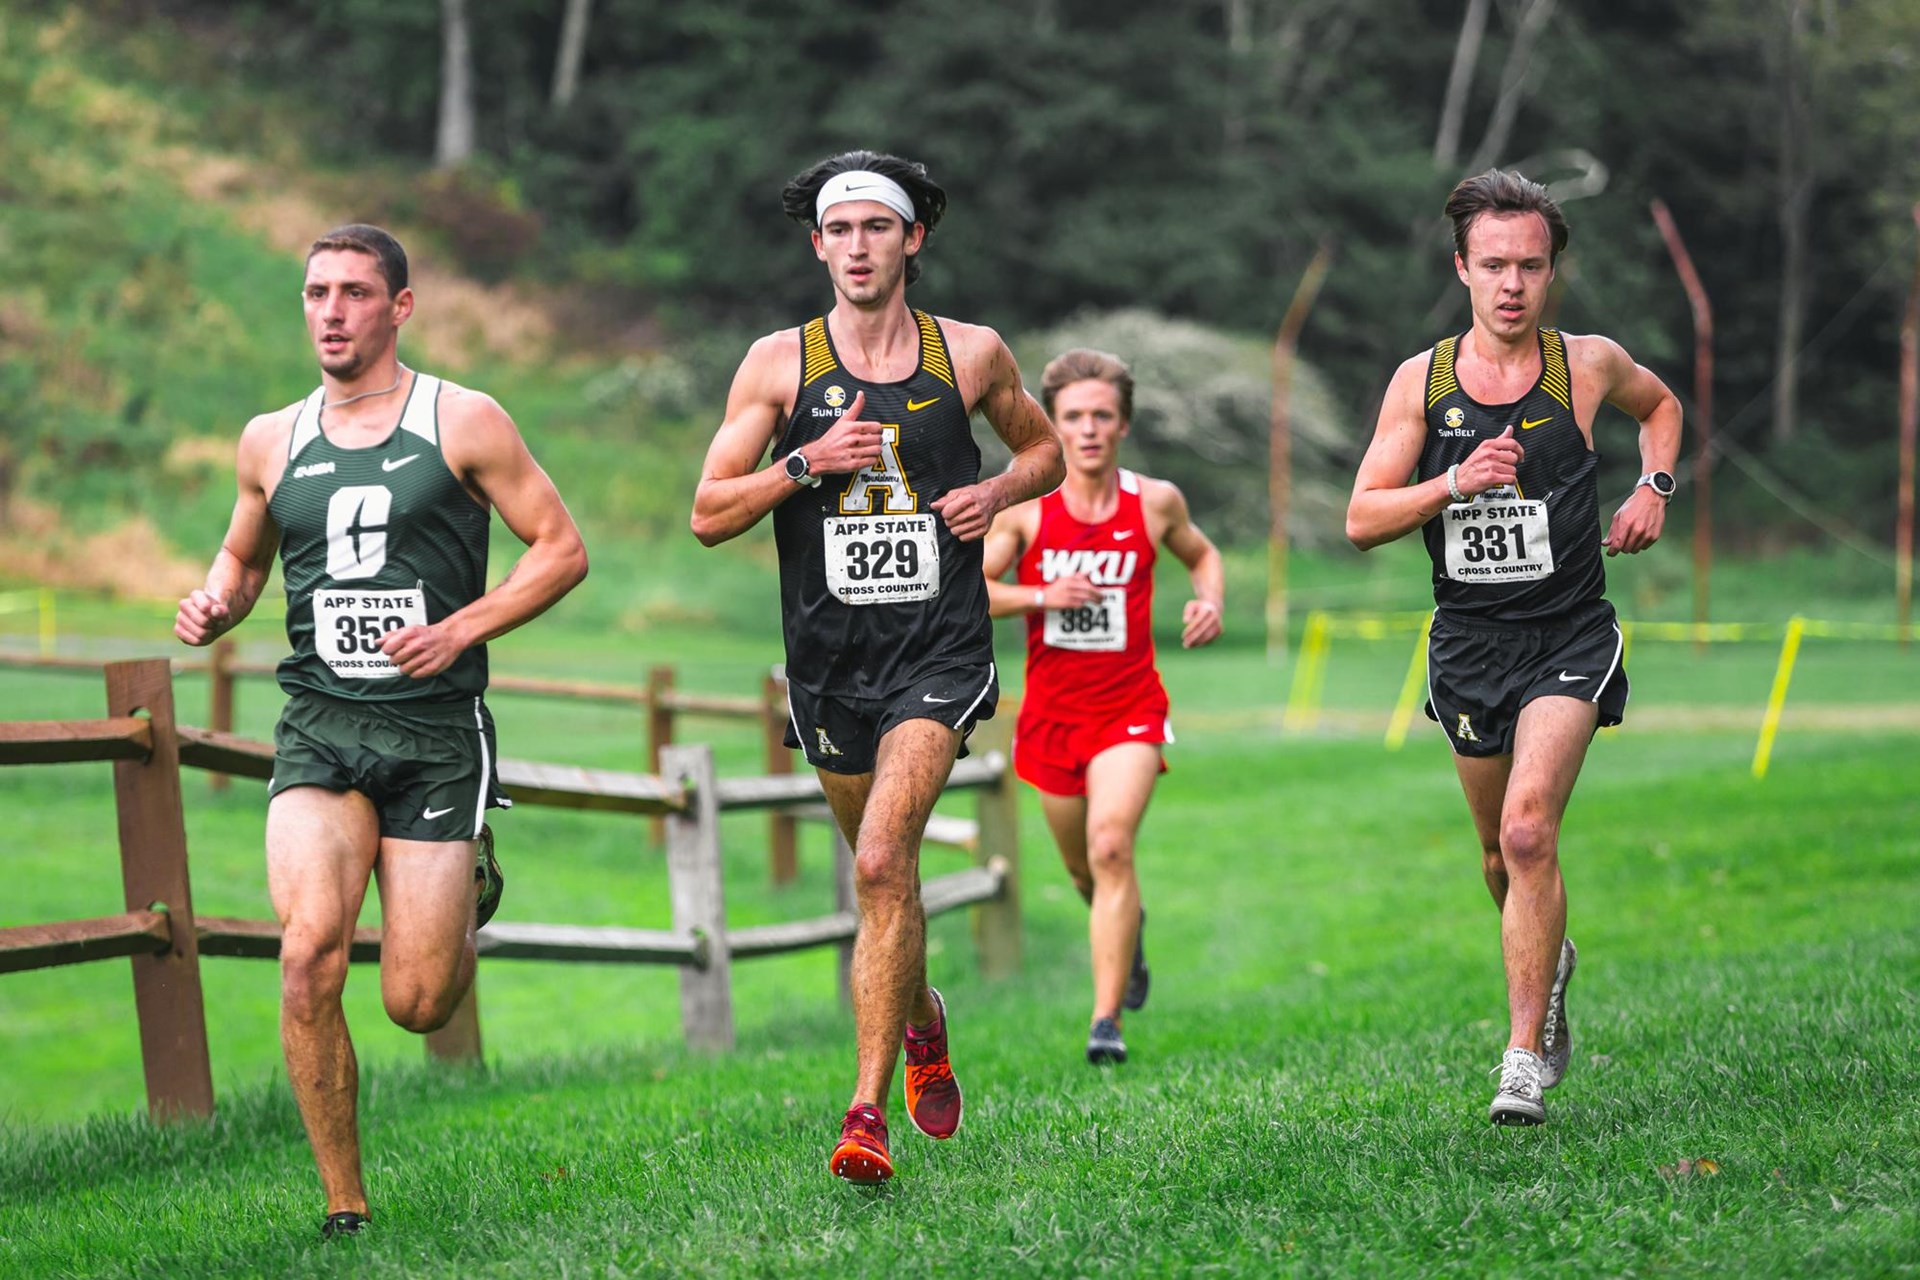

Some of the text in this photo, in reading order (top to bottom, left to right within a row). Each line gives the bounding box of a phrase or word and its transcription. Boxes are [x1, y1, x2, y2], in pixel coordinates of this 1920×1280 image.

[1454, 428, 1476, 437] BELT
[839, 424, 918, 515] A
[1451, 505, 1537, 521] APP STATE
[834, 520, 927, 536] APP STATE
[1462, 523, 1527, 563] 331
[846, 539, 919, 581] 329
[1042, 548, 1138, 586] WKU
[1457, 563, 1543, 575] CROSS COUNTRY
[838, 583, 930, 595] CROSS COUNTRY
[324, 597, 414, 609] APP STATE
[328, 660, 398, 668] CROSS COUN
